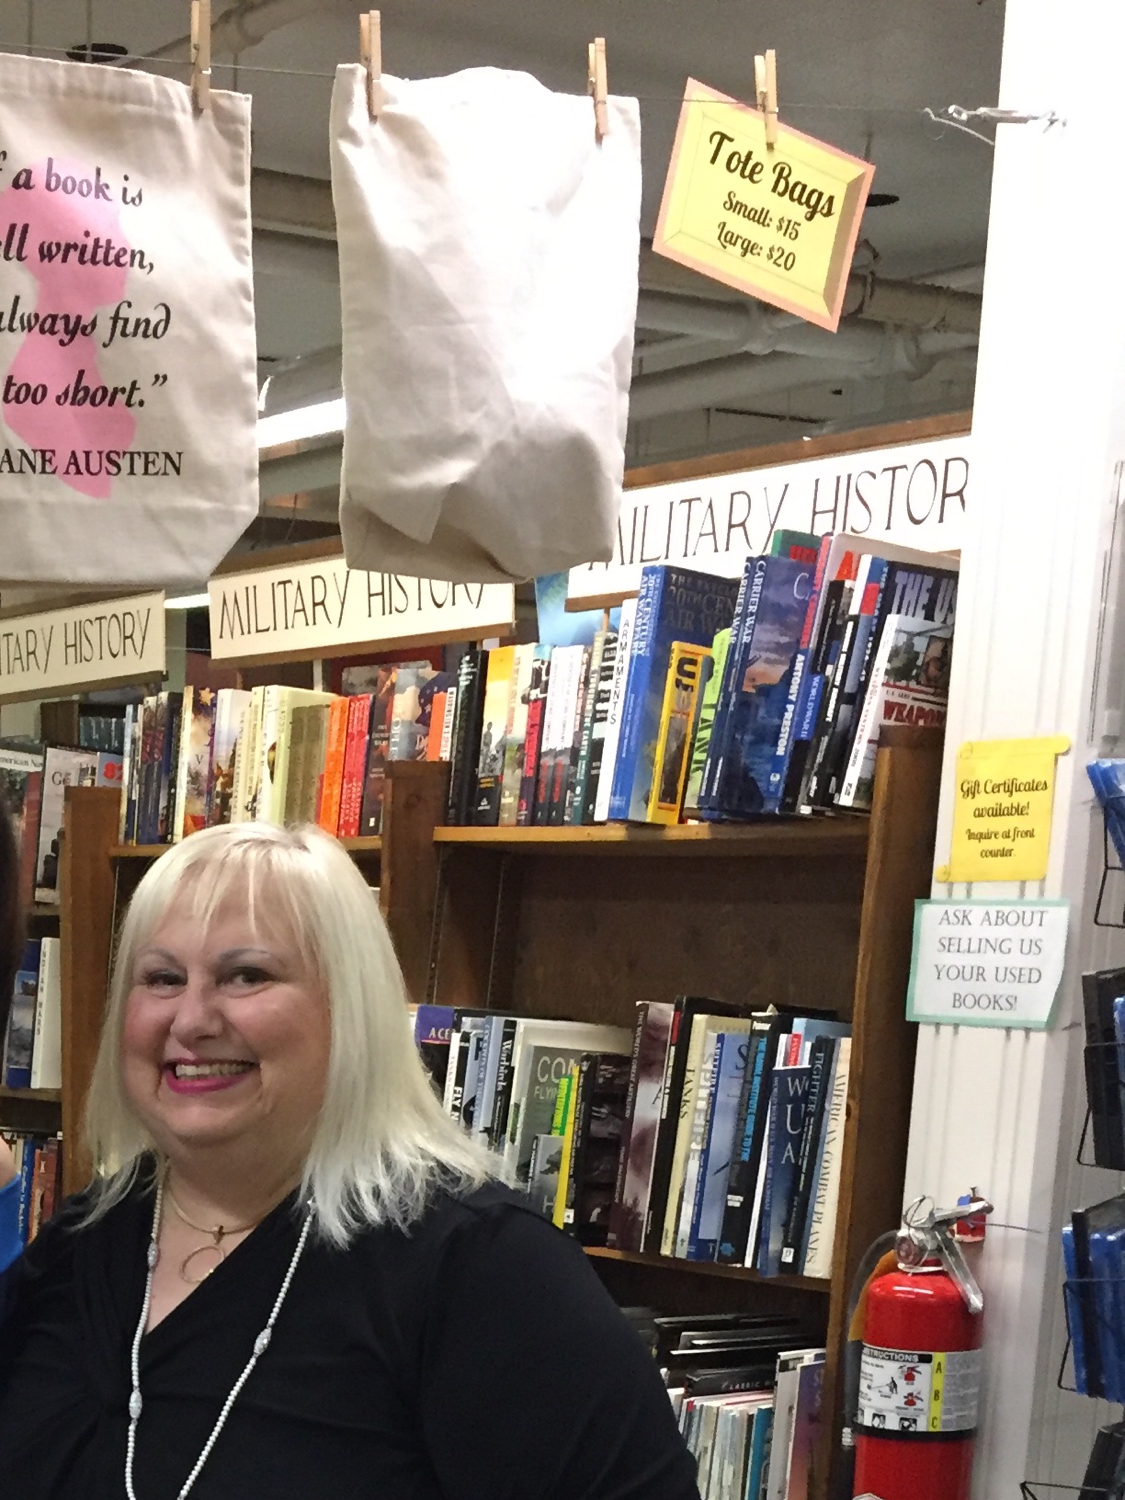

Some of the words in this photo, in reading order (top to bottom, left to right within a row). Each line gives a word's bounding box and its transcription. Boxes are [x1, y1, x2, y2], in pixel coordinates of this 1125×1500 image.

[12, 168, 35, 190] a
[45, 157, 112, 201] book
[122, 174, 143, 206] is
[709, 131, 763, 184] Tote
[771, 162, 835, 222] Bags
[723, 191, 772, 227] Small:
[777, 217, 801, 240] $15
[38, 230, 154, 275] written,
[718, 222, 763, 257] Large:
[767, 245, 796, 271] $20
[102, 301, 171, 348] find
[2, 375, 48, 406] too
[56, 370, 167, 408] short.”
[63, 451, 183, 476] AUSTEN
[810, 457, 969, 534] HISTOR
[219, 571, 350, 639] MILITARY
[648, 574, 656, 598] 20TH
[732, 562, 751, 614] CARRIER
[747, 561, 767, 613] CARRIER
[64, 608, 151, 665] HISTORY
[638, 598, 653, 656] CENTURY
[742, 615, 755, 643] WAR
[609, 619, 630, 725] ARMAMENTS
[788, 654, 806, 703] ANTONY
[803, 675, 820, 711] WORLD
[883, 700, 946, 724] WEAPON
[776, 703, 797, 756] PRESTON
[800, 712, 812, 731] WAR
[961, 780, 980, 798] Gift
[983, 779, 1049, 797] Certificates
[973, 801, 1029, 818] available!
[966, 828, 999, 843] Inquire
[1002, 830, 1011, 839] at
[1012, 827, 1035, 841] front
[938, 909, 973, 926] ASK
[980, 910, 1049, 927] ABOUT
[937, 937, 1013, 955] SELLING
[1020, 939, 1042, 955] US
[933, 964, 986, 982] YOUR
[995, 967, 1042, 984] USED
[952, 993, 1017, 1011] BOOKS!
[496, 1039, 513, 1091] Warbirds
[754, 1052, 764, 1077] NAVAL
[758, 1037, 767, 1052] THE
[710, 1043, 721, 1094] SPITFIRE
[806, 1052, 824, 1112] FIGHTER
[452, 1086, 462, 1107] FLY
[680, 1067, 695, 1119] TANKS
[691, 1053, 713, 1161] SPITFIRE
[748, 1077, 760, 1114] INSTITUTE
[825, 1074, 847, 1145] AMERICAN
[743, 1137, 752, 1146] TO
[744, 1115, 756, 1136] GUIDE
[815, 1151, 833, 1205] COMBAT
[806, 1212, 824, 1264] PLANES
[935, 1362, 943, 1374] A
[933, 1390, 940, 1402] B
[931, 1416, 938, 1429] C
